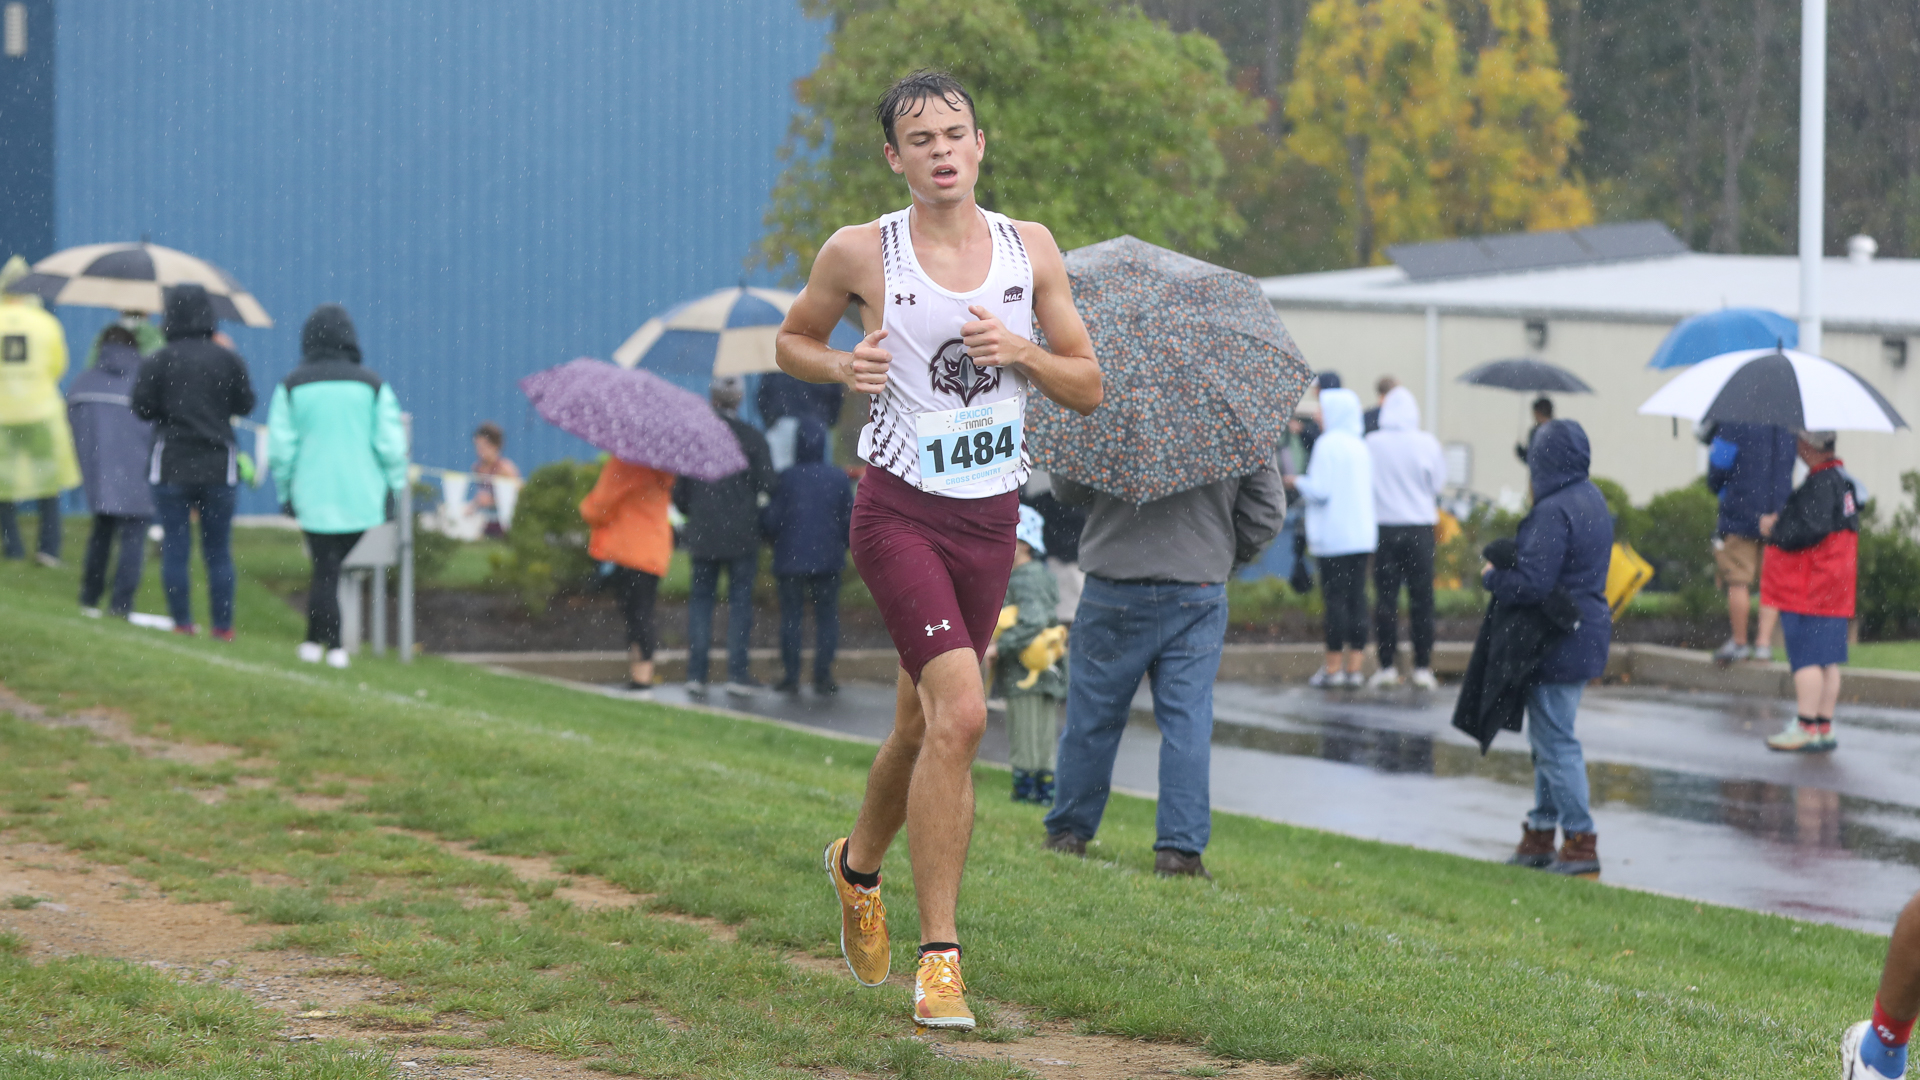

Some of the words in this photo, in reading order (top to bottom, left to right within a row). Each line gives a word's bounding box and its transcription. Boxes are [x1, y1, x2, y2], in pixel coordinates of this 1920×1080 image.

[1004, 293, 1022, 302] MAC
[954, 407, 993, 423] LEXICON
[961, 417, 993, 430] TIMING
[926, 425, 1014, 473] 1484
[945, 475, 970, 485] CROSS
[972, 467, 1001, 480] COUNTRY
